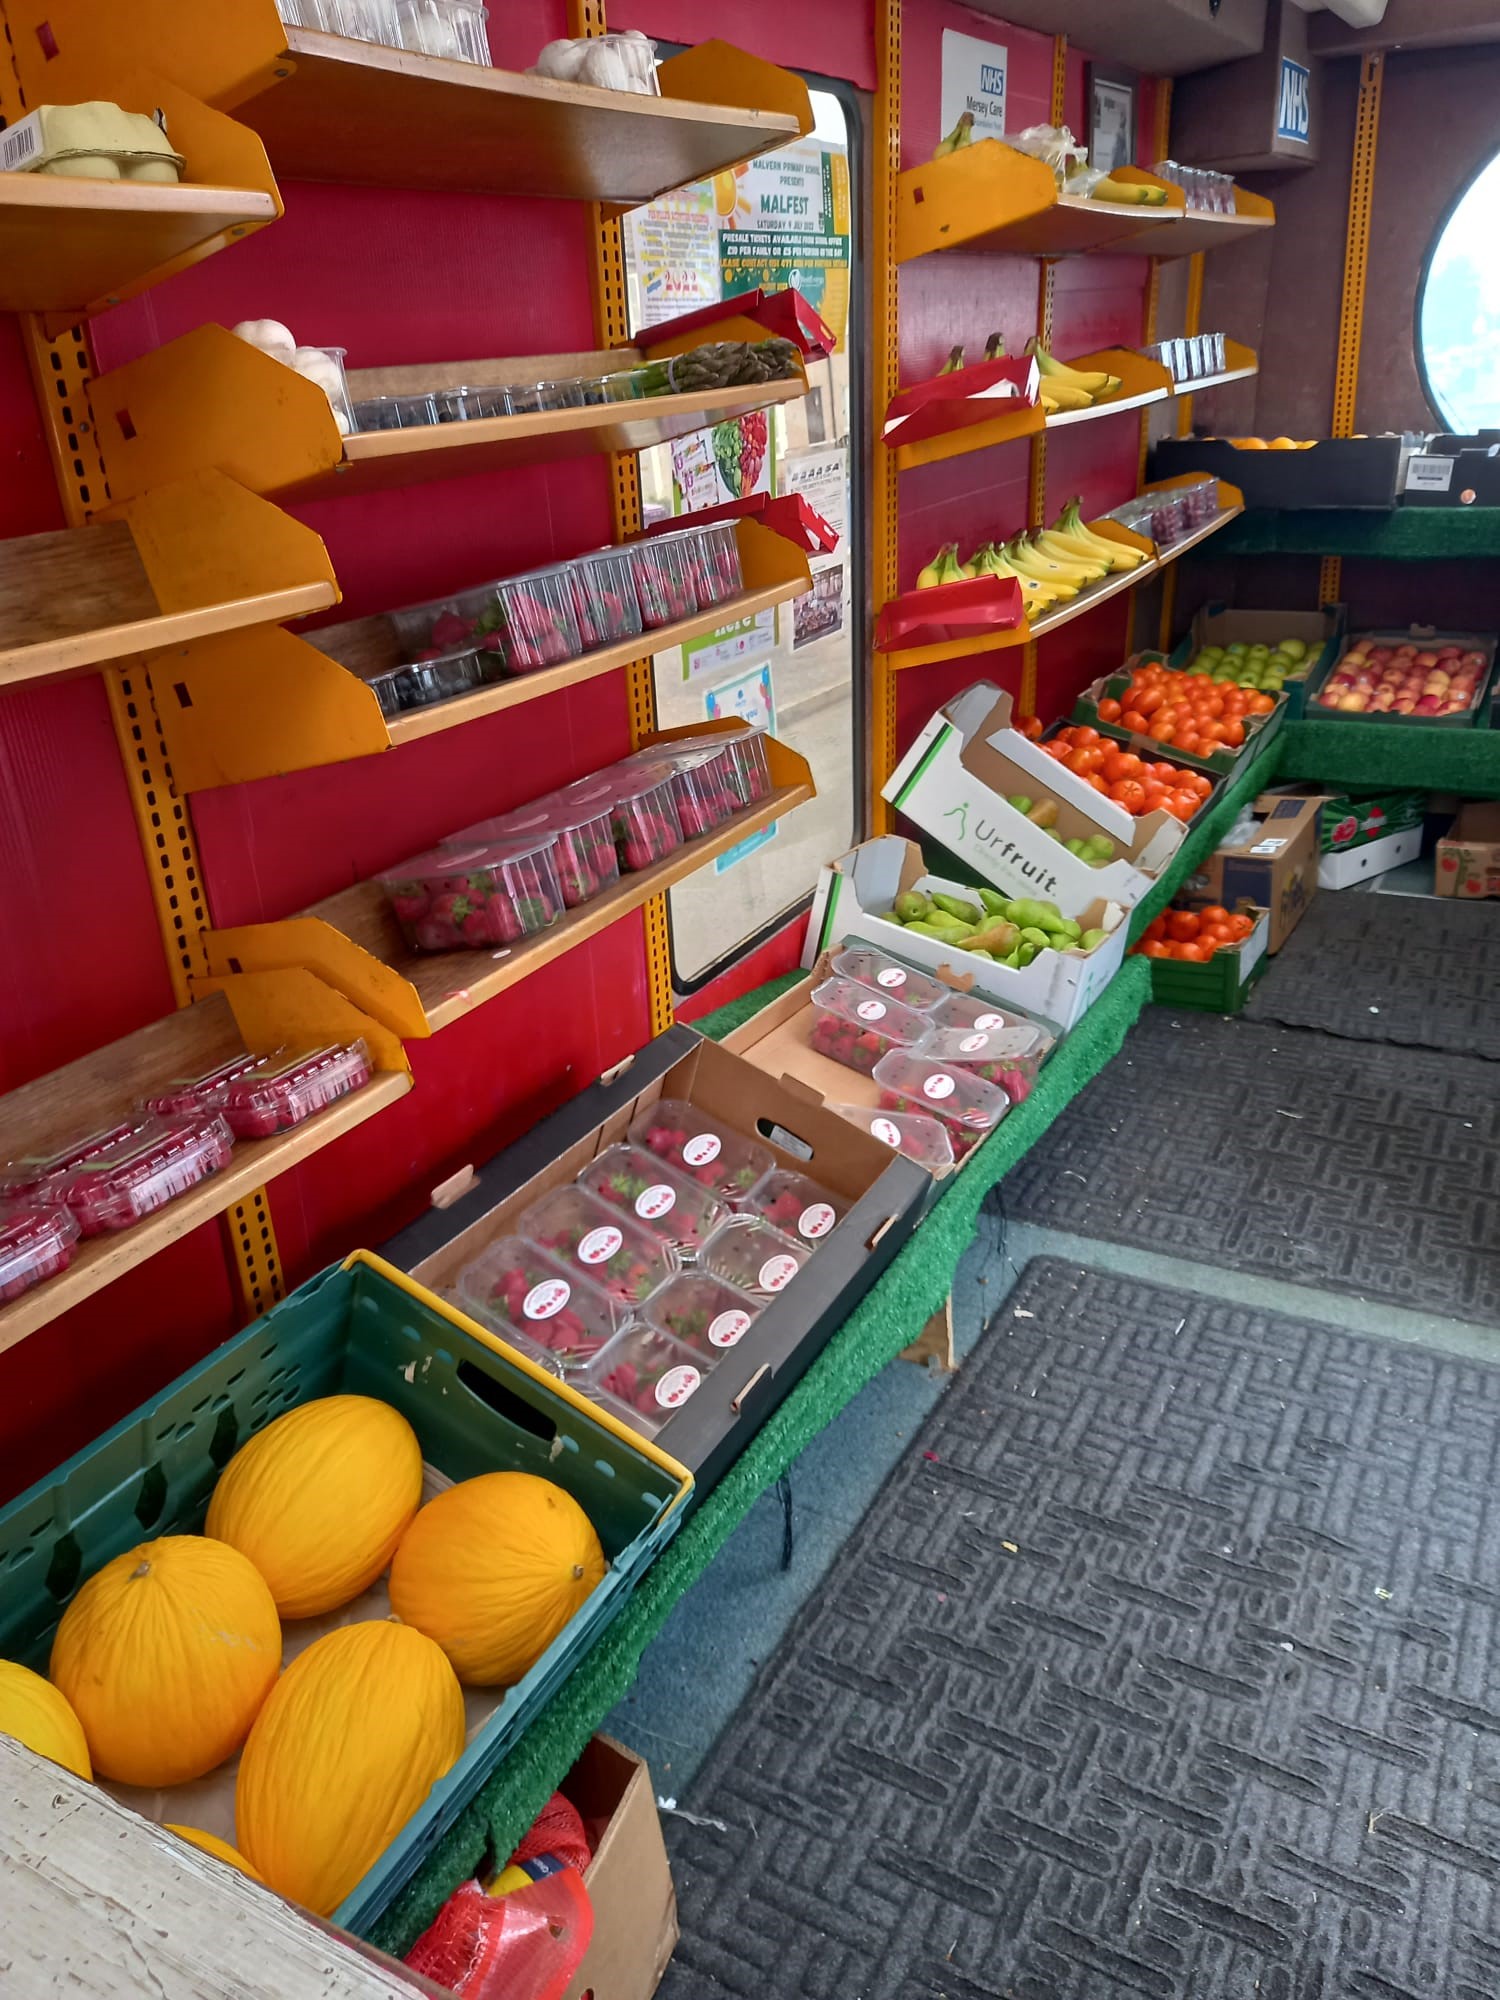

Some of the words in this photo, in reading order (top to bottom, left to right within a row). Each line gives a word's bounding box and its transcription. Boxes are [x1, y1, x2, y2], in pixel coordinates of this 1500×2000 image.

[981, 67, 1002, 94] NHS
[966, 95, 988, 118] Mersey
[989, 100, 1003, 118] Care
[1280, 65, 1309, 136] NHS
[753, 160, 781, 170] MALVERN
[761, 195, 809, 215] MALFEST
[757, 221, 786, 231] SATURDAY
[723, 234, 749, 243] PRESALE
[740, 246, 752, 256] PER
[753, 246, 772, 256] FAMILY
[975, 819, 1057, 893] Urfruit
